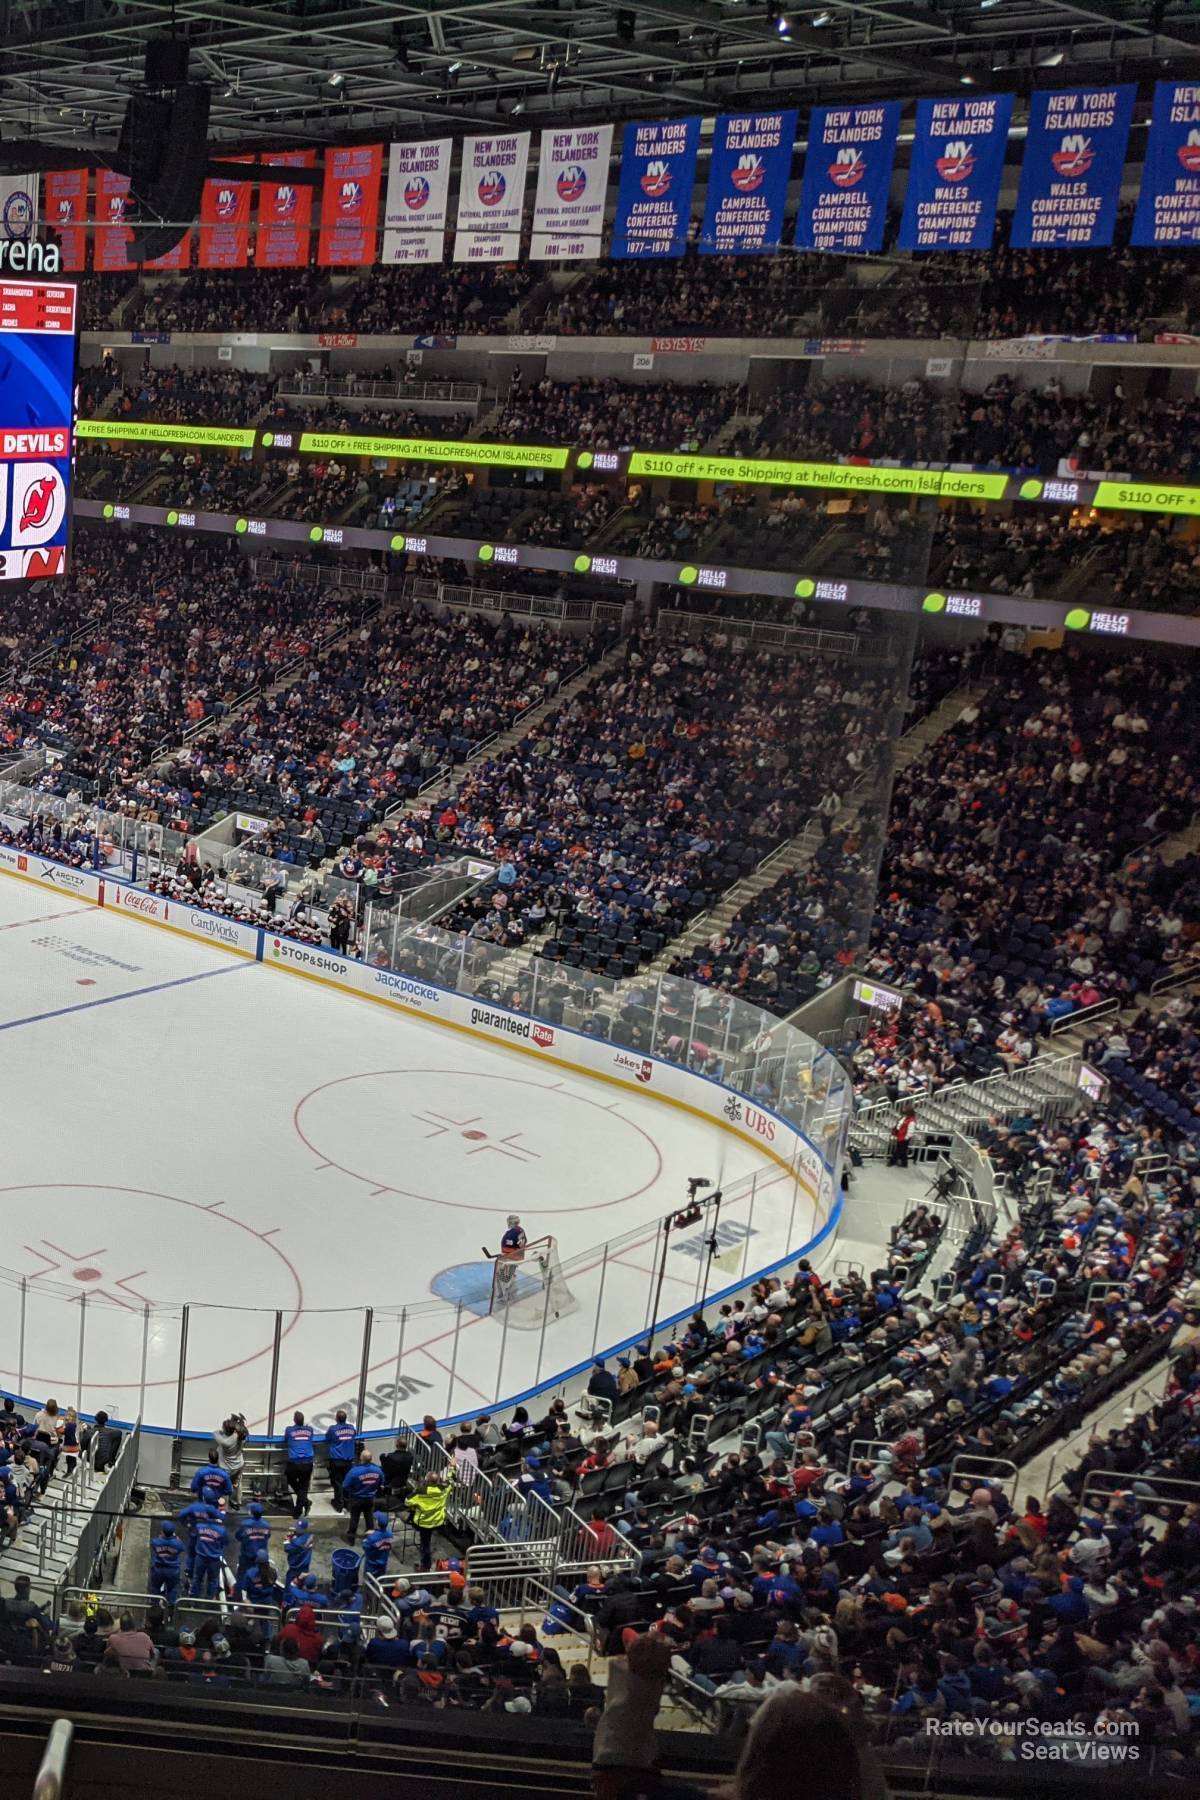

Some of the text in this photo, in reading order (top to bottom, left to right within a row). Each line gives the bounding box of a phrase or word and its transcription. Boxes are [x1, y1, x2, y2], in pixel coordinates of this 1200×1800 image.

[1048, 92, 1117, 111] NEW YORK
[933, 101, 995, 118] NEW YORK
[825, 109, 885, 126] NEW YORK
[1045, 112, 1114, 129] ISLANDERS
[637, 124, 686, 139] NEW YORK
[728, 117, 782, 133] NEW YORK
[930, 119, 993, 136] ISLANDERS
[553, 132, 599, 147] NEW YORK
[726, 133, 779, 149] ISLANDERS
[823, 126, 881, 143] ISLANDERS
[401, 145, 439, 160] NEW YORK
[474, 139, 517, 153] NEW YORK
[635, 141, 685, 156] ISLANDERS
[474, 154, 516, 167] ISLANDERS
[552, 148, 598, 162] ISLANDERS
[400, 160, 438, 173] ISLANDERS
[935, 187, 968, 199] WALES
[1051, 183, 1087, 196] WALES
[722, 197, 766, 209] CAMPBELL
[819, 193, 868, 205] CAMPBELL
[1032, 198, 1102, 212] CONFERENCE
[632, 202, 673, 214] CAMPBELL
[812, 206, 872, 219] CONFERENCE
[918, 202, 981, 215] CONFERENCE
[627, 215, 678, 227] CONFERENCE
[715, 210, 770, 222] CONFERENCE
[918, 216, 976, 229] CHAMPIONS
[1032, 213, 1096, 227] CHAMPIONS
[716, 224, 765, 236] CHAMPIONS
[813, 221, 866, 233] CHAMPIONS
[87, 426, 105, 434] FREE
[107, 427, 139, 436] SHIPPING
[3, 435, 65, 454] DEVILS
[311, 439, 329, 449] $110
[331, 441, 345, 449] OFF
[353, 441, 371, 451] FREE
[373, 443, 410, 453] SHIPPING
[412, 445, 422, 454] AT
[644, 460, 672, 472] $110
[676, 461, 695, 473] off
[707, 464, 734, 477] Free
[738, 466, 791, 482] Shipping
[796, 469, 809, 481] at
[1044, 482, 1078, 492] HELLO
[1043, 491, 1078, 500] FRESH
[1118, 491, 1184, 505] $110 OFF
[948, 597, 980, 607] HELLO
[946, 606, 979, 616] FRESH
[1092, 613, 1128, 624] HELLO
[1090, 622, 1127, 633] FRESH
[55, 872, 84, 885] ARCTIX
[190, 911, 239, 940] CardWorks
[282, 946, 348, 975] STOP&SHOP
[375, 972, 440, 1002] Jackpocket
[471, 1007, 553, 1041] guaranteed Rate
[745, 1106, 775, 1141] UBS
